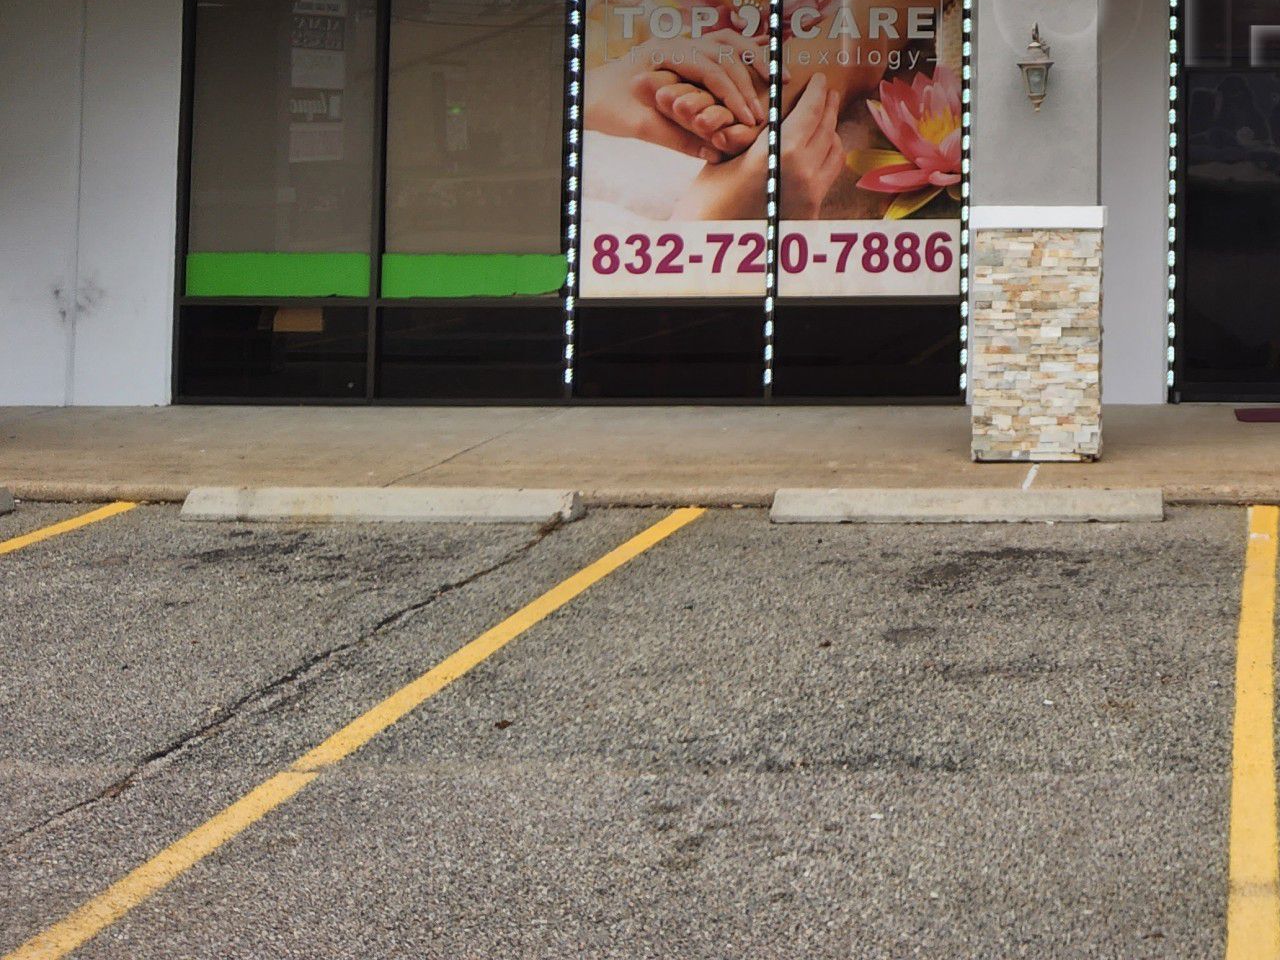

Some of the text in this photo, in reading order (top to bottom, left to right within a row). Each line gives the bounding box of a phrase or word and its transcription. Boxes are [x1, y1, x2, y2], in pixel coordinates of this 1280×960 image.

[613, 6, 936, 39] TOP CARE
[592, 232, 953, 276] 832-720-7886
